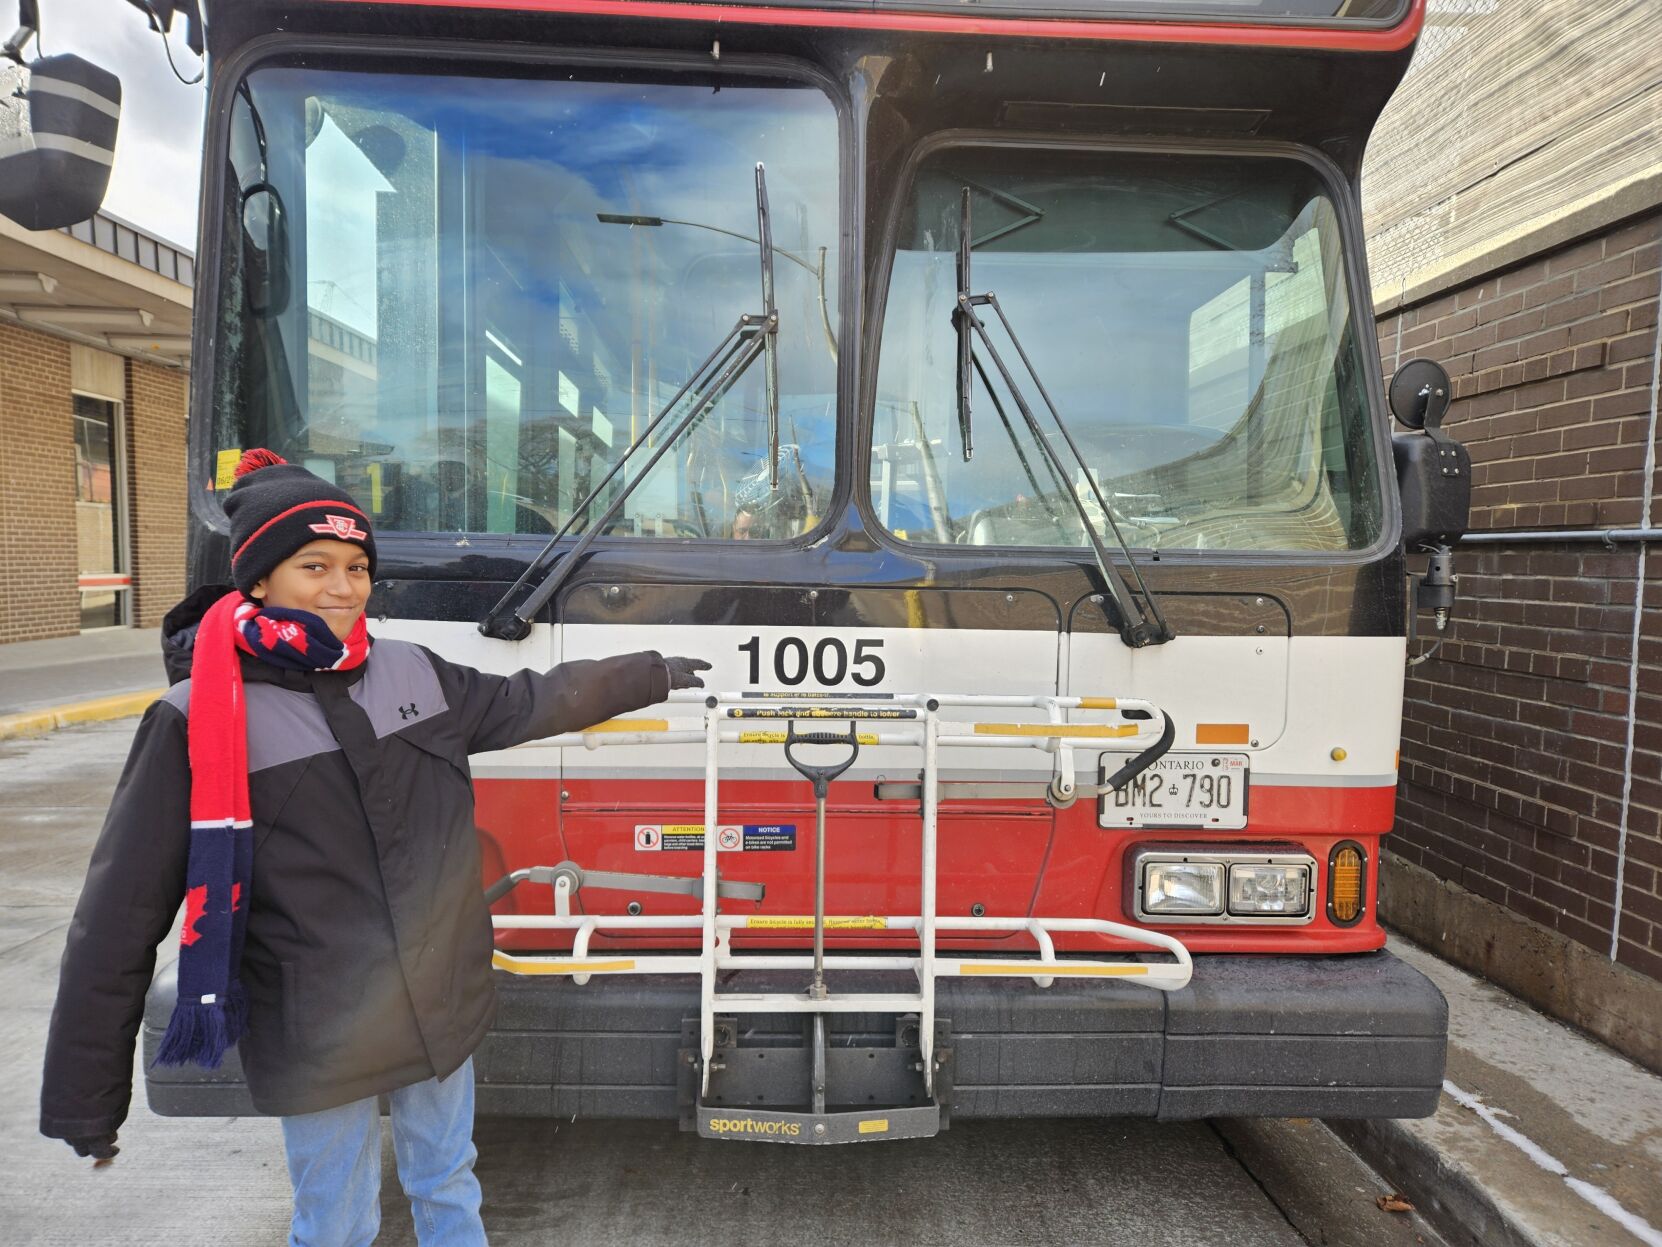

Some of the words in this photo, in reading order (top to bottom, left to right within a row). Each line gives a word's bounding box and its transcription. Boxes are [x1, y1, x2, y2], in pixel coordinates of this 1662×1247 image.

[738, 636, 886, 687] 1005
[1148, 760, 1204, 771] ONTARIO
[1183, 773, 1231, 809] 790
[1174, 812, 1208, 820] DISCOVER
[709, 1118, 800, 1136] sportworks
